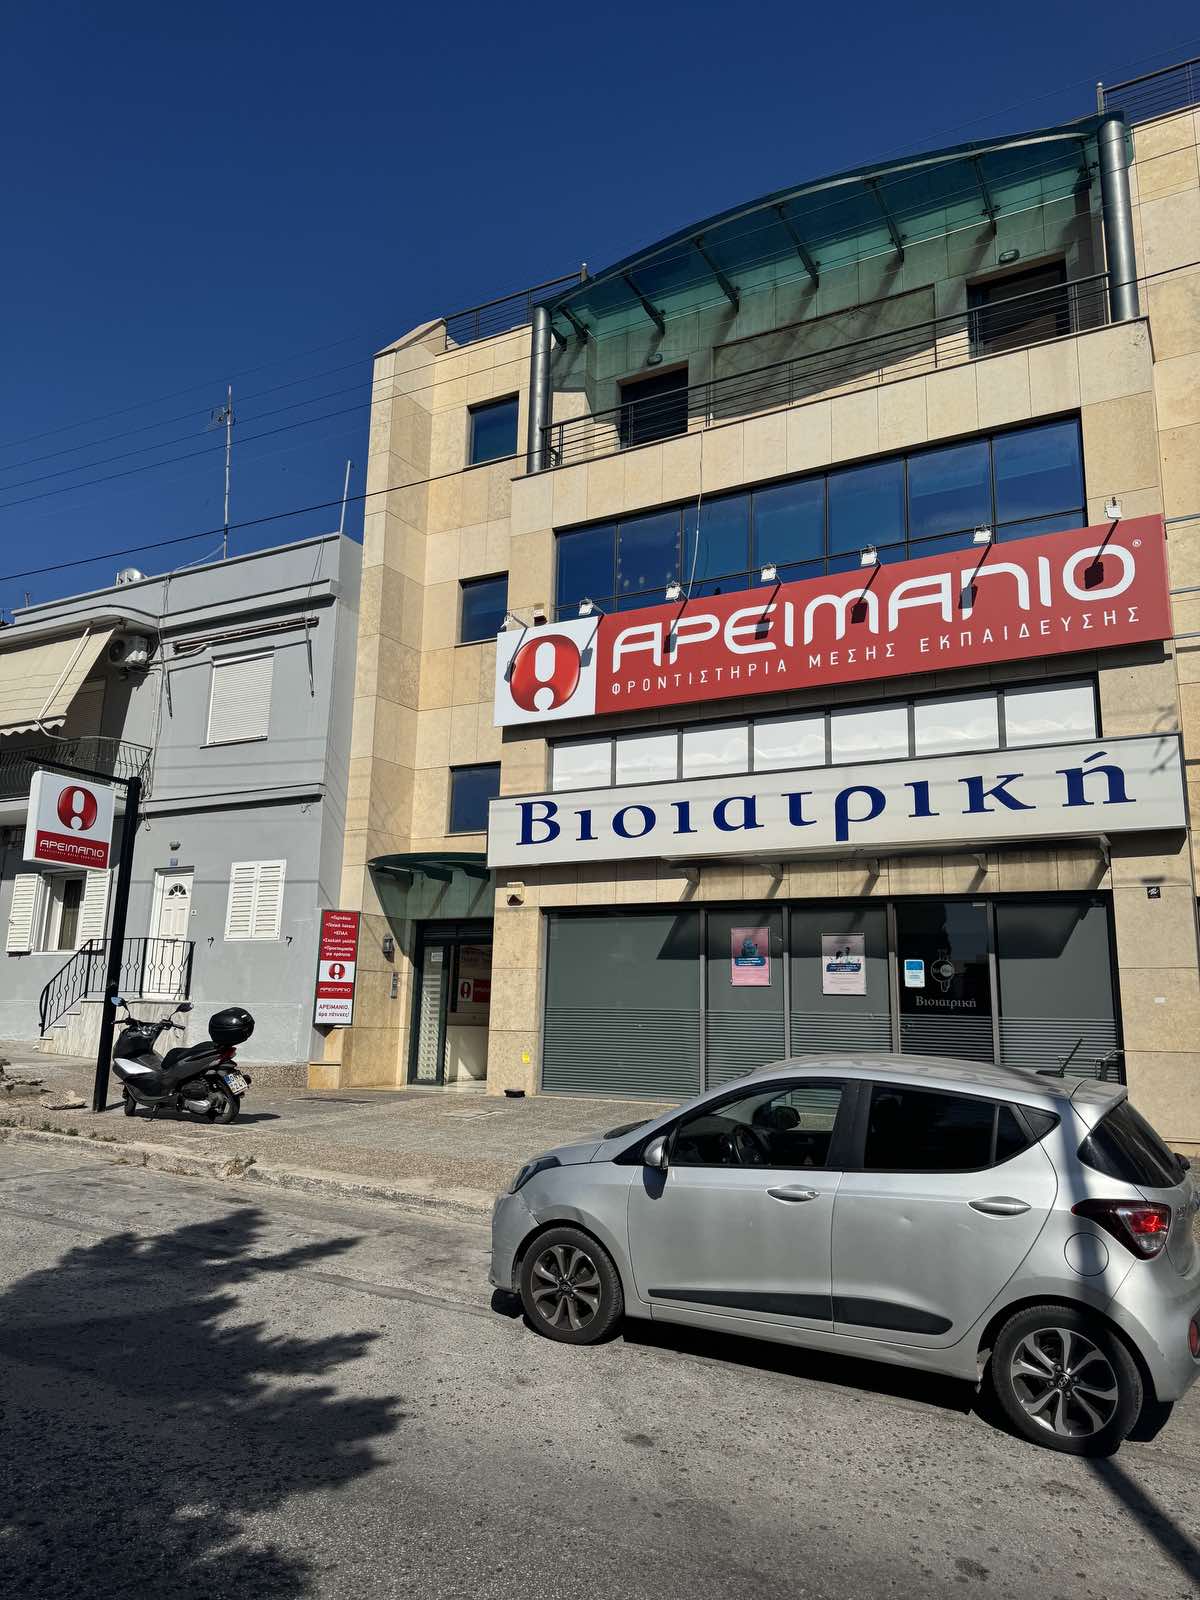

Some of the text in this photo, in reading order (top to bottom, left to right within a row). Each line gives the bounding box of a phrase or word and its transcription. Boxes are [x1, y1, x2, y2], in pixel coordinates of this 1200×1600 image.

[611, 606, 1140, 695] ΦΡΟΝΤΙΣΤΗΡΙΑ ΜΕΣΗΣ ΕΚΠΑΙΔΕΥΣΗΣ
[514, 751, 1137, 847] Βιοιατρική
[915, 995, 977, 1009] Βιοιατρική
